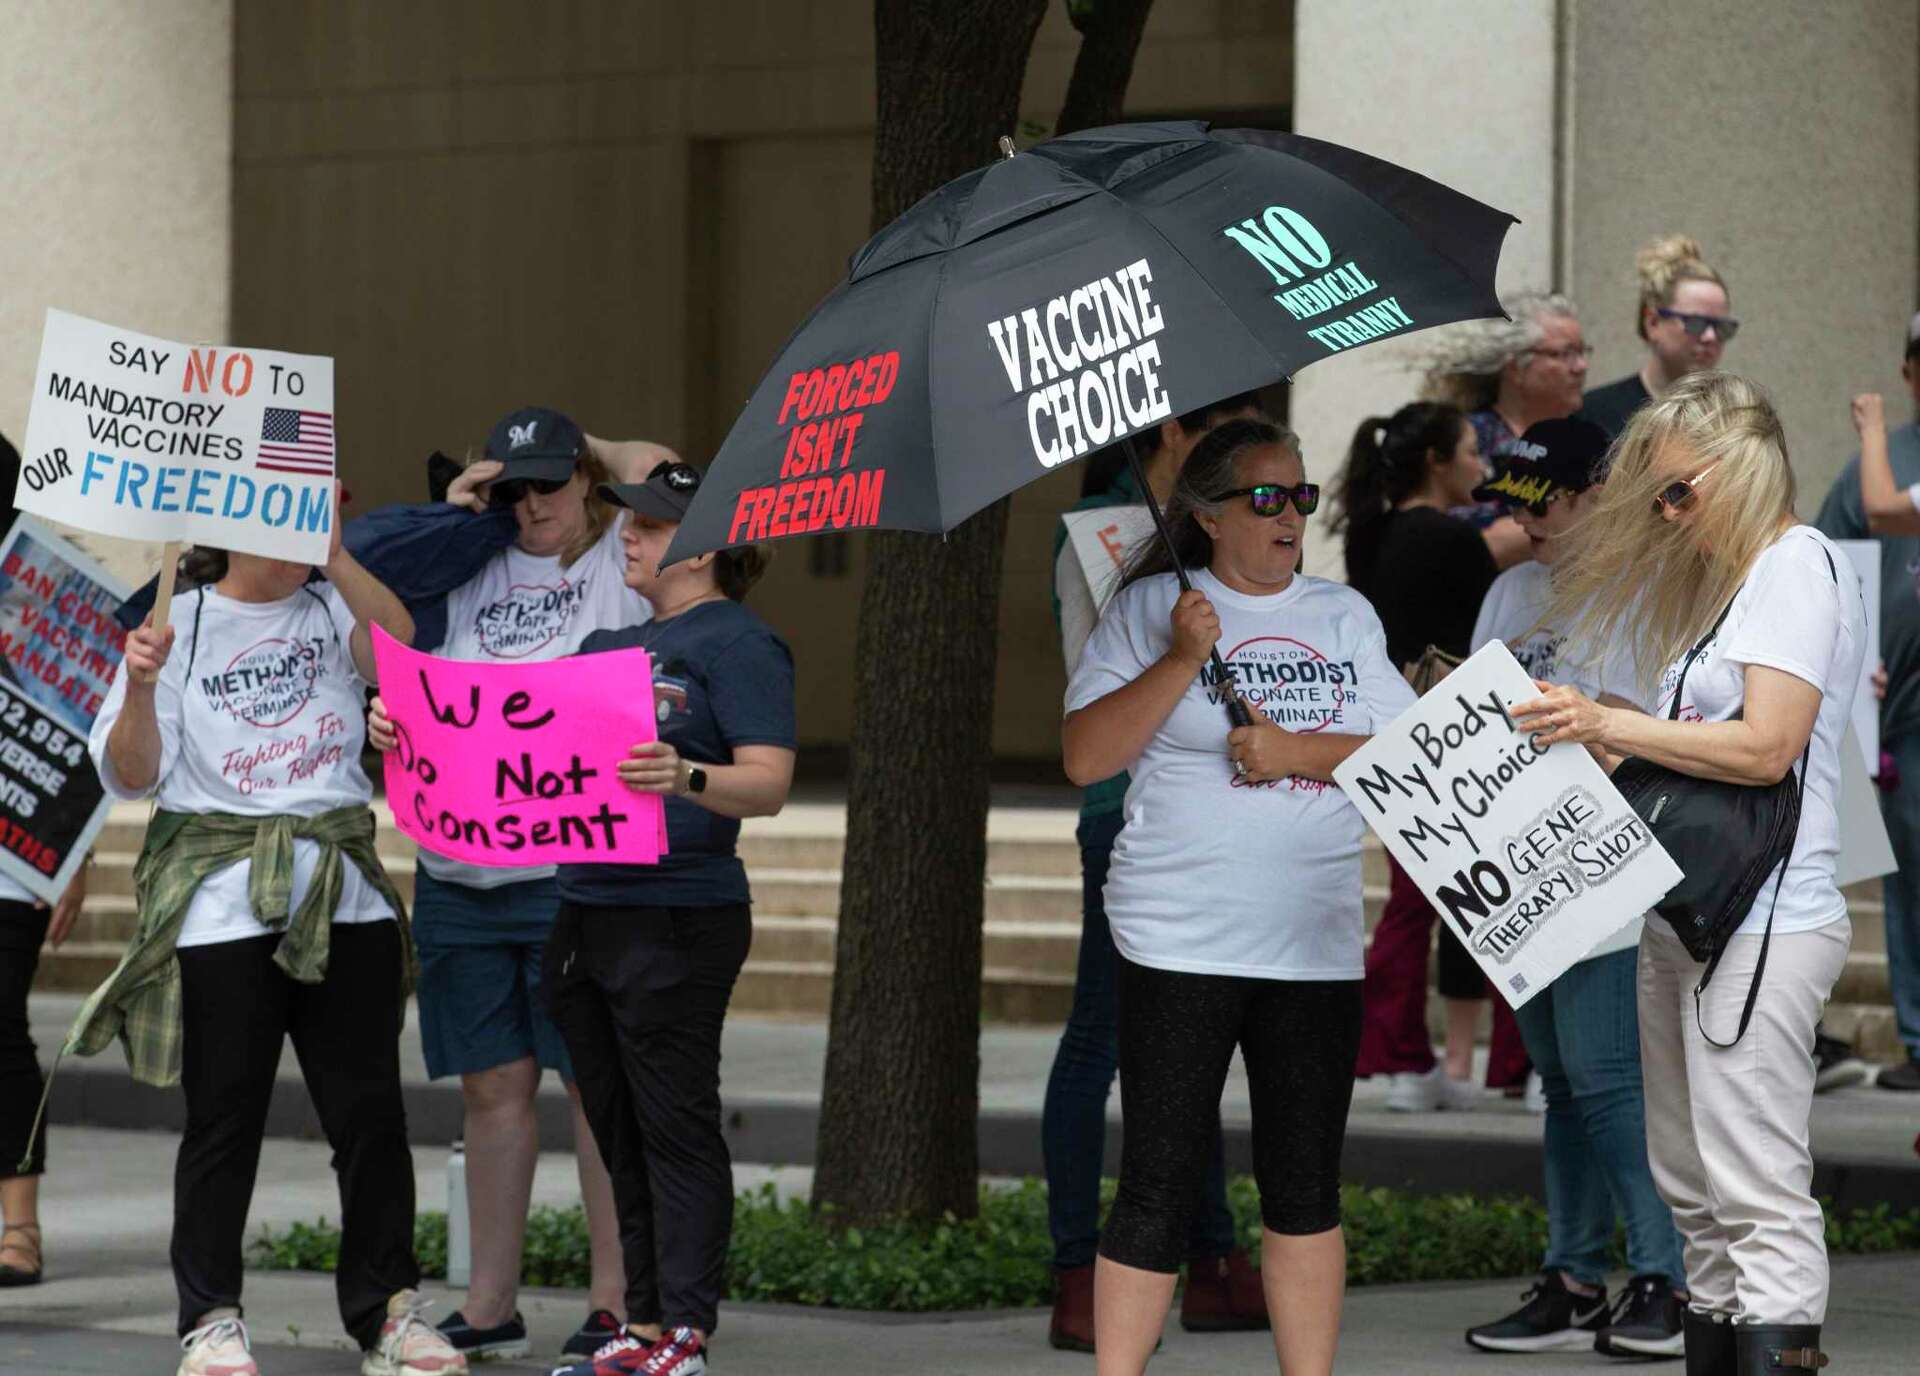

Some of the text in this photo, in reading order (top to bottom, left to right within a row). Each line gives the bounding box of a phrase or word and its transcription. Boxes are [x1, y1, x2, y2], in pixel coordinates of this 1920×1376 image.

[1224, 205, 1332, 286] NO
[1273, 261, 1379, 321] MEDICAL
[988, 258, 1165, 393] VACCINE
[1307, 297, 1415, 352] TYRANNY
[109, 341, 304, 397] SAY NO TO
[777, 350, 899, 425] FORCED
[49, 373, 224, 428] MANDATORY
[1027, 339, 1172, 469] CHOICE
[87, 414, 243, 461] VACCINES
[780, 412, 864, 479] ISN'T
[23, 447, 329, 533] OUR FREEDOM
[728, 468, 885, 544] FREEDOM
[3, 552, 56, 601] BAN
[1239, 650, 1310, 661] HOUSTON
[420, 669, 556, 730] We
[1331, 689, 1358, 704] OR
[391, 719, 597, 799] Do Not
[1356, 763, 1441, 815] My
[414, 791, 627, 850] Consent
[1398, 812, 1481, 863] My
[1435, 794, 1594, 938] NO GENE
[1478, 818, 1643, 954] THERAPY SHOT
